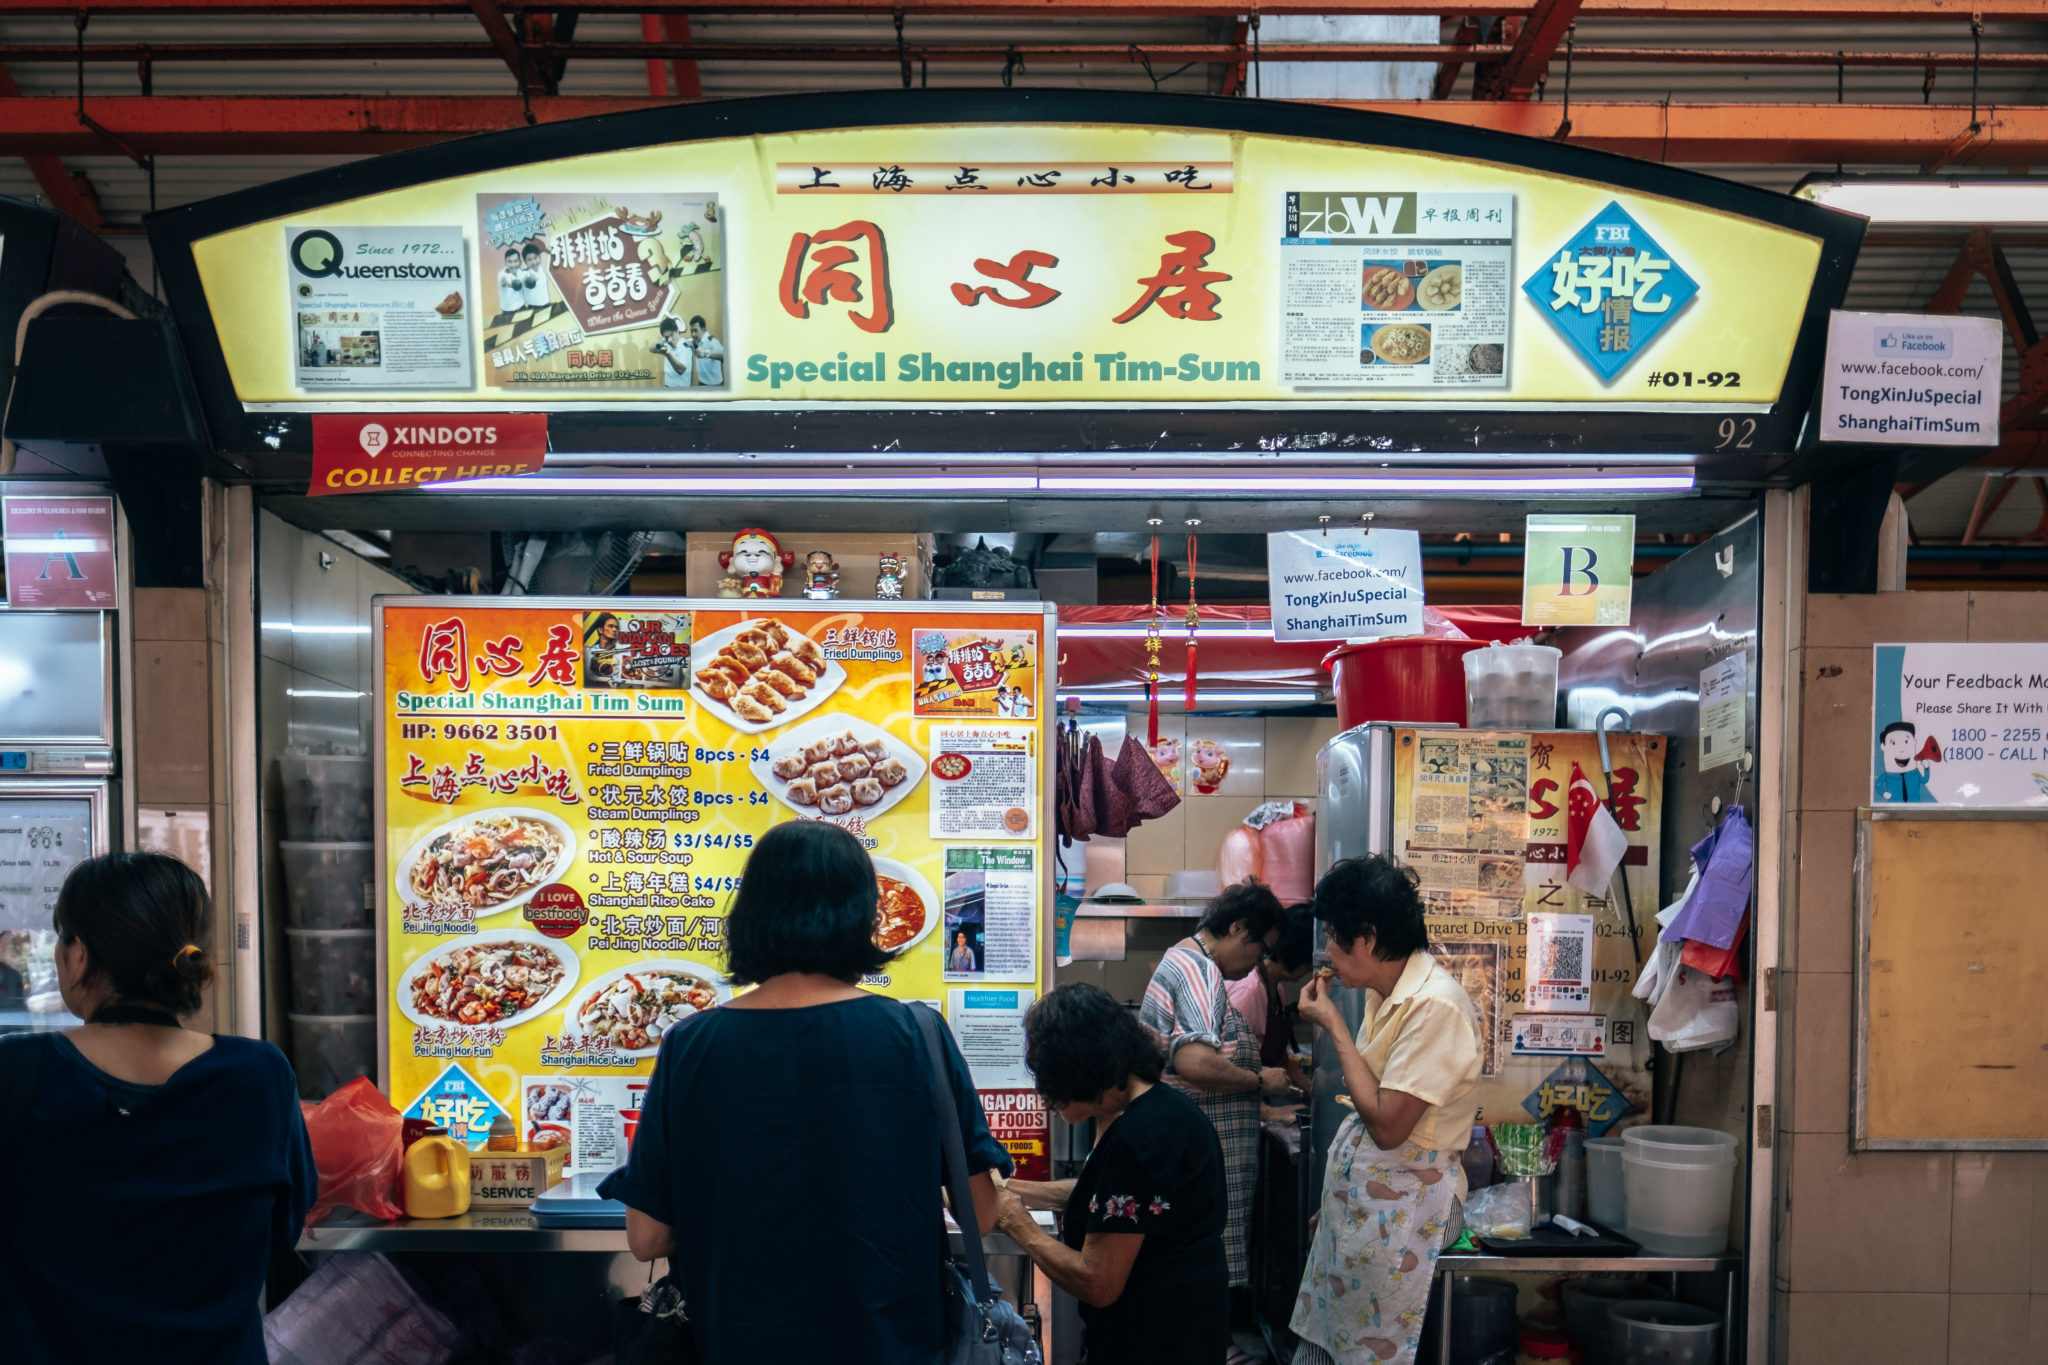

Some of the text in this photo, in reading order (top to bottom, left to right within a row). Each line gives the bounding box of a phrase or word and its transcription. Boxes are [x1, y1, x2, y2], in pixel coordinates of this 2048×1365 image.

[797, 163, 1213, 194] 上海点心小吃
[1421, 207, 1503, 223] 早报周刊
[1595, 227, 1631, 241] FBI
[290, 229, 462, 280] Queenstown
[355, 243, 394, 255] Since
[550, 225, 625, 269] 排排站
[778, 220, 1234, 333] 同心居
[1550, 250, 1672, 314] 好吃
[1599, 296, 1632, 352] 情报
[1901, 333, 1915, 341] Like
[1901, 341, 1946, 352] Facebook
[567, 350, 614, 369] 同心居
[549, 371, 588, 382] Margaret
[589, 371, 612, 380] Drive
[745, 351, 1261, 391] Special Shanghai Tim-Sum
[1647, 371, 1741, 388] #01-92
[1841, 361, 1984, 380] www.facebook.com/
[1840, 385, 1982, 407] TongXinJuSpecial
[1838, 413, 1981, 434] ShanghaiTimSum
[392, 427, 497, 445] XINDOTS
[1714, 418, 1757, 449] 92
[392, 449, 496, 458] CONNECTING CHANGE
[326, 466, 447, 489] COLLECT
[35, 528, 89, 580] A
[1283, 565, 1407, 584] www.facebook.com/
[1556, 545, 1600, 597] B
[1284, 587, 1407, 608] TongXinJuSpecial
[1286, 612, 1408, 632] ShanghaiTimSum
[618, 631, 676, 645] MAKAN
[822, 627, 897, 648] 三鲜锅贴
[418, 616, 581, 692] 同心居
[823, 648, 902, 661] Fried Dumplings
[1903, 673, 1941, 689] Your
[1946, 673, 2023, 689] Feedback
[396, 691, 684, 714] Special Shanghai Tim Sum
[1915, 702, 2043, 714] Please Share It With
[401, 722, 559, 741] HP: 9662 3501
[1951, 728, 2041, 742] 1800 2255
[600, 741, 690, 762] 三鲜锅贴
[694, 746, 770, 764] 8pcs $4
[1531, 740, 1555, 771] 贺
[1943, 747, 2038, 763] (1800 CALL
[400, 752, 580, 806] 上海点心小吃
[588, 763, 691, 779] Fried Dumplings
[601, 784, 690, 806] 状元水饺
[693, 790, 769, 807] 8pcs $4
[588, 807, 700, 823] Steam Dumplings
[601, 828, 667, 850] 酸辣汤
[673, 832, 754, 850] $3/$4/$5
[1532, 827, 1560, 837] 1972
[588, 850, 693, 866] Hot & Sour Soup
[980, 855, 1026, 865] The Window
[601, 872, 690, 893] 上海年糕
[547, 893, 575, 902] LOVE
[588, 894, 715, 909] Shanghai Rice Cake
[402, 902, 475, 921] 北京炒面
[525, 904, 588, 924] bestfoody
[403, 922, 477, 933] Pei Jing Noodle
[600, 915, 727, 937] 北京炒面/河
[1424, 921, 1513, 938] rgaret Drive
[1594, 923, 1644, 938] 02-480
[589, 938, 722, 952] Pei Jing Noodle Hor
[864, 974, 890, 985] Soup
[967, 995, 1016, 1003] Healthier Food
[413, 1025, 506, 1046] 北京炒河粉
[540, 1033, 615, 1054] 上海年糕
[414, 1046, 492, 1058] Pei Jing Hor Fun
[540, 1055, 636, 1067] Shanghai Rice Cake
[444, 1081, 466, 1092] FBI
[979, 1093, 1047, 1111] GAPORE
[1538, 1082, 1613, 1121] 好吃
[420, 1096, 491, 1134] 好吃
[998, 1112, 1044, 1128] FOODS
[991, 1130, 1021, 1139] NJOY
[1009, 1142, 1033, 1150] FOODS
[471, 1186, 536, 1199] -SERVICE
